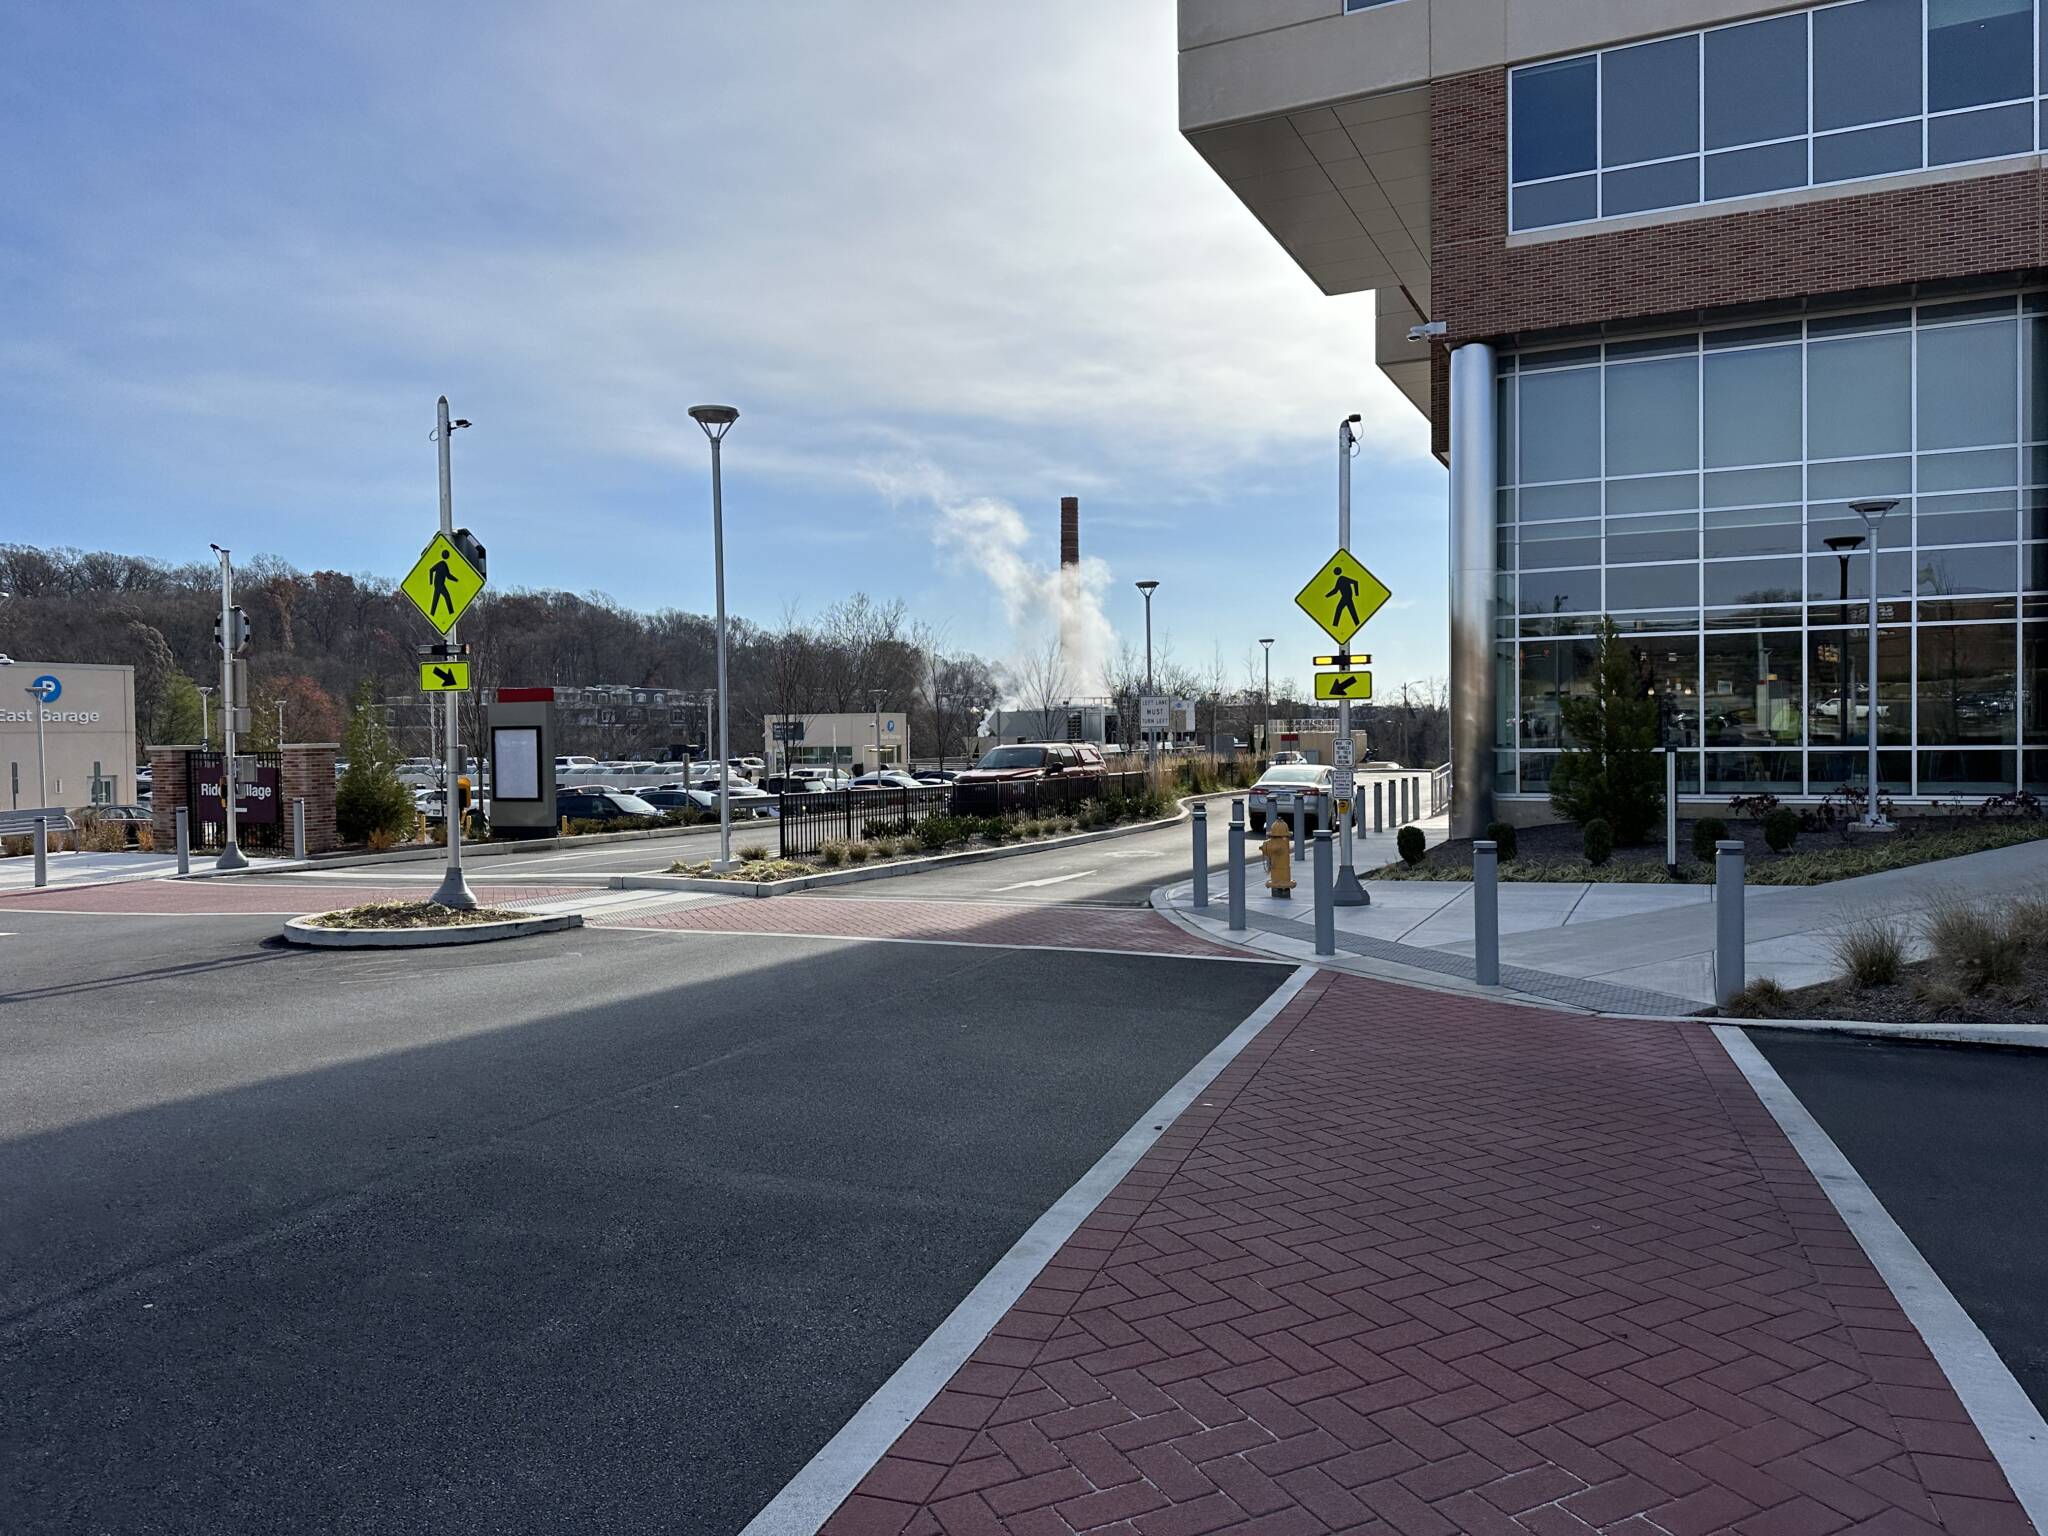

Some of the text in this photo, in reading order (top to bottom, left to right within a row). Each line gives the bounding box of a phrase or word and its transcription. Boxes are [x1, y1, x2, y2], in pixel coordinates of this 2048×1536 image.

[42, 680, 56, 698] P
[0, 708, 101, 726] East Garage
